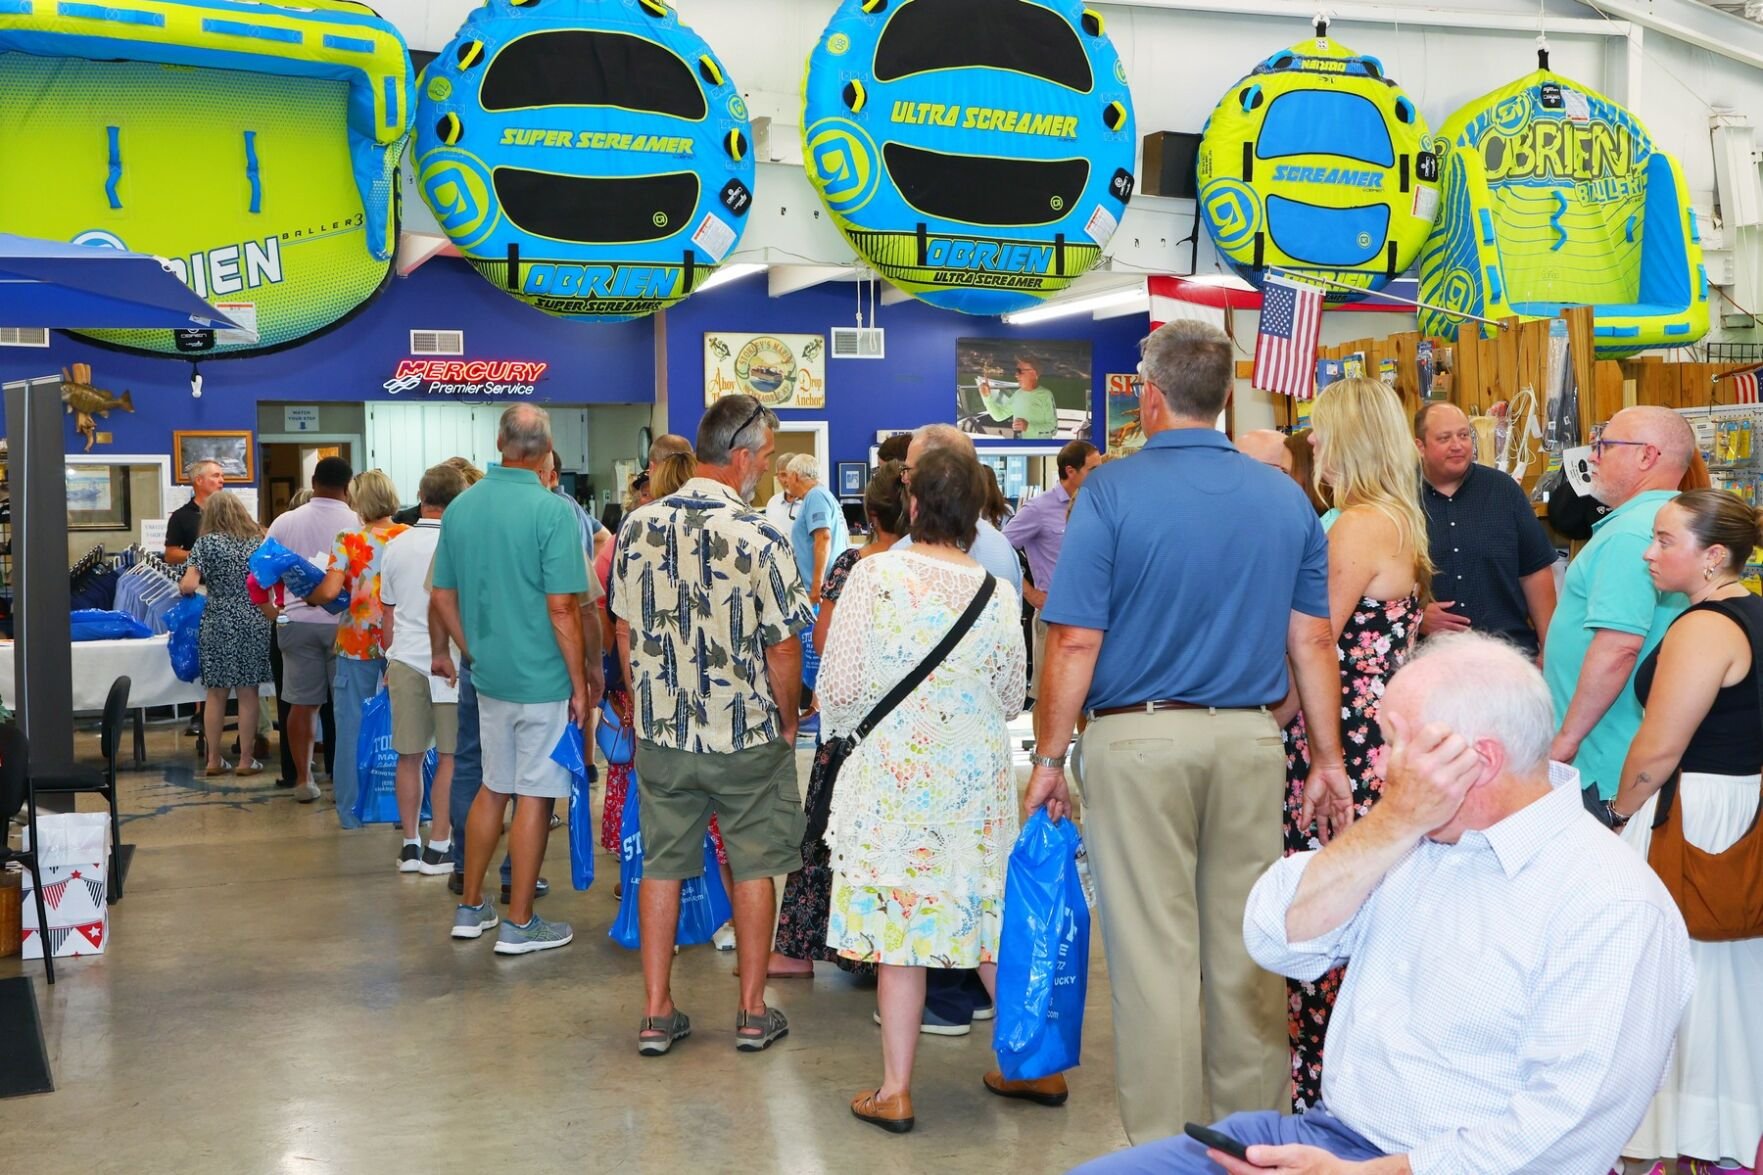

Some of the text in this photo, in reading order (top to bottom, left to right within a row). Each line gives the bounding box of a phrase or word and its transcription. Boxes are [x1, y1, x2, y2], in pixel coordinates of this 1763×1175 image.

[890, 101, 1079, 138] ULTRA SCREAMER
[500, 128, 694, 154] SUPER SCREAMER
[1272, 165, 1384, 188] SCREAMER
[168, 235, 284, 300] IEN
[926, 239, 1054, 274] OBRIEN
[523, 264, 680, 299] OBRIEN
[933, 272, 1043, 288] ULTRA SCREAMER
[534, 298, 582, 311] SUPER
[395, 360, 546, 382] MERCURY
[708, 368, 735, 393] Ahoy
[798, 368, 822, 392] Drop
[428, 381, 534, 395] Premier Service
[1110, 375, 1139, 396] SK
